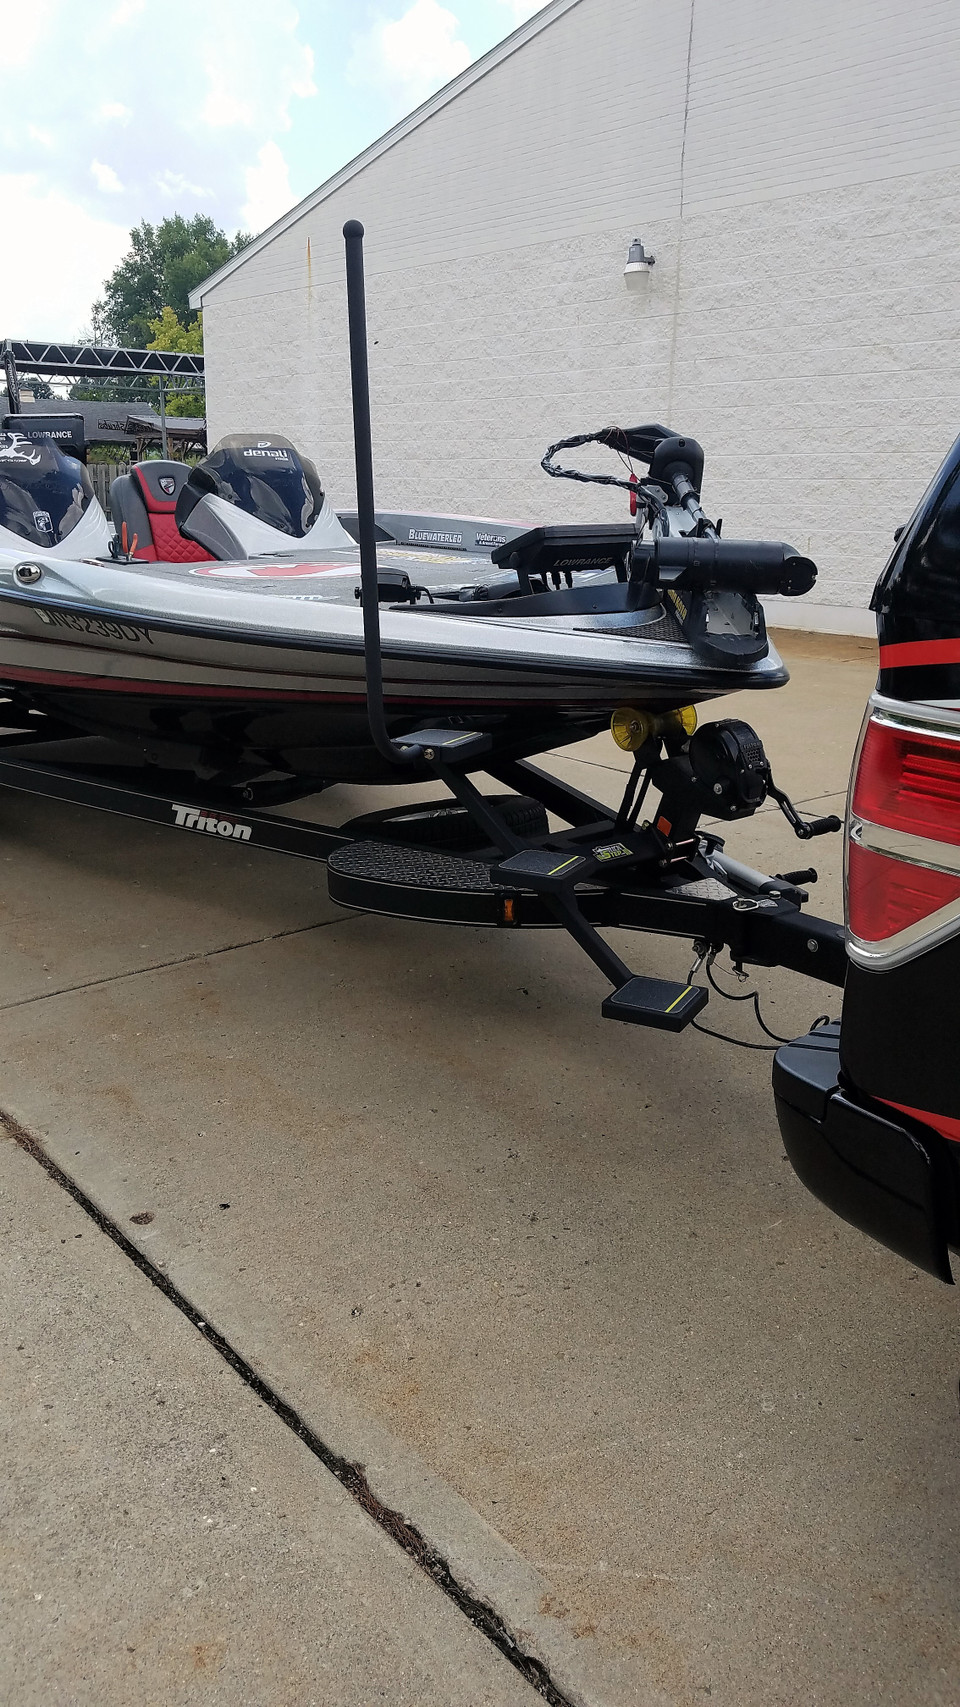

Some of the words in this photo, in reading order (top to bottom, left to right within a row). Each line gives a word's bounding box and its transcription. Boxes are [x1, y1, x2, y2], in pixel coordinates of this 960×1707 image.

[243, 449, 288, 458] denali
[553, 557, 613, 567] LOWRANCE
[171, 804, 252, 840] Triton
